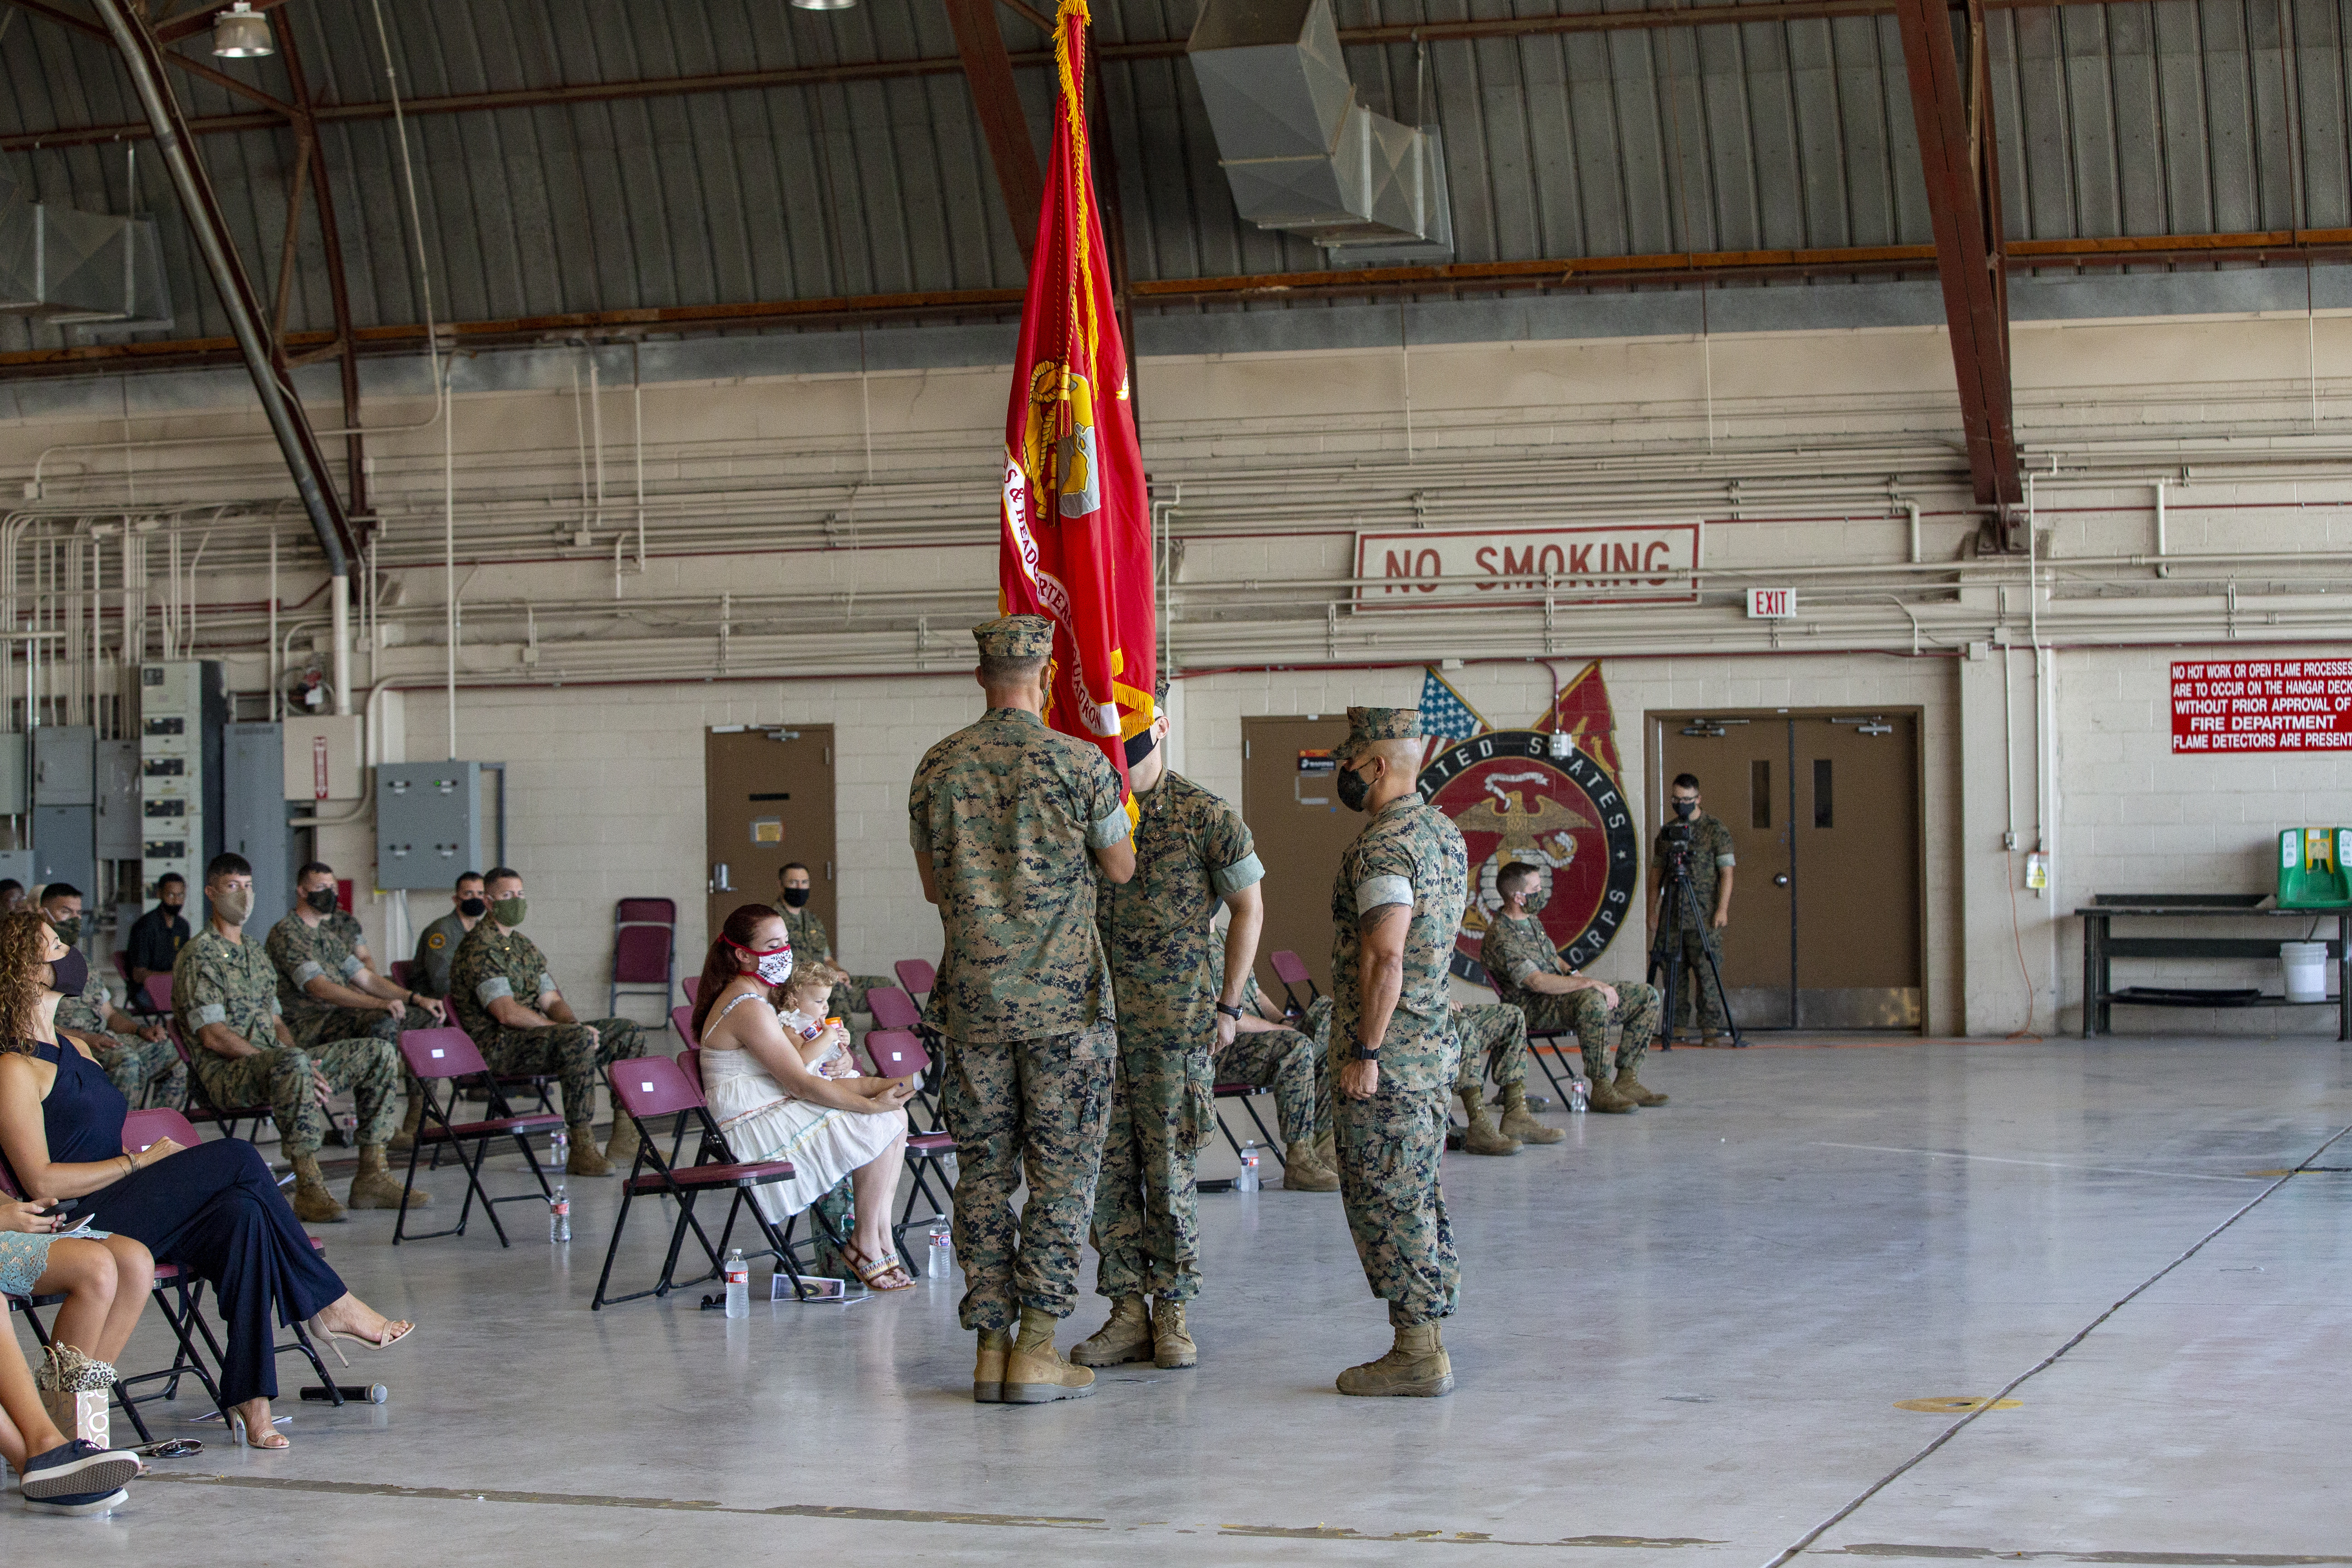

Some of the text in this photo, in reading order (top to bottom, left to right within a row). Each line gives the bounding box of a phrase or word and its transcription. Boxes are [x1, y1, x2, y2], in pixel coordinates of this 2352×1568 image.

[1009, 488, 1024, 503] &
[1385, 540, 1671, 593] NO SMOKING
[1756, 591, 1787, 614] EXIT
[2172, 661, 2352, 680] NO HOT WORK OR OPEN FLAME PROCESSES
[2173, 679, 2352, 697] ARE TO OCCUR ON THE HANGAR DECK
[2175, 696, 2352, 715] WITHOUT PRIOR APPROVAL OF
[2190, 715, 2337, 731] FIRE DEPARTMENT
[2173, 731, 2352, 749] FLAME DETECTORS ARE PRESENT
[1529, 737, 1626, 828] SATES
[1569, 889, 1626, 965] ORPS
